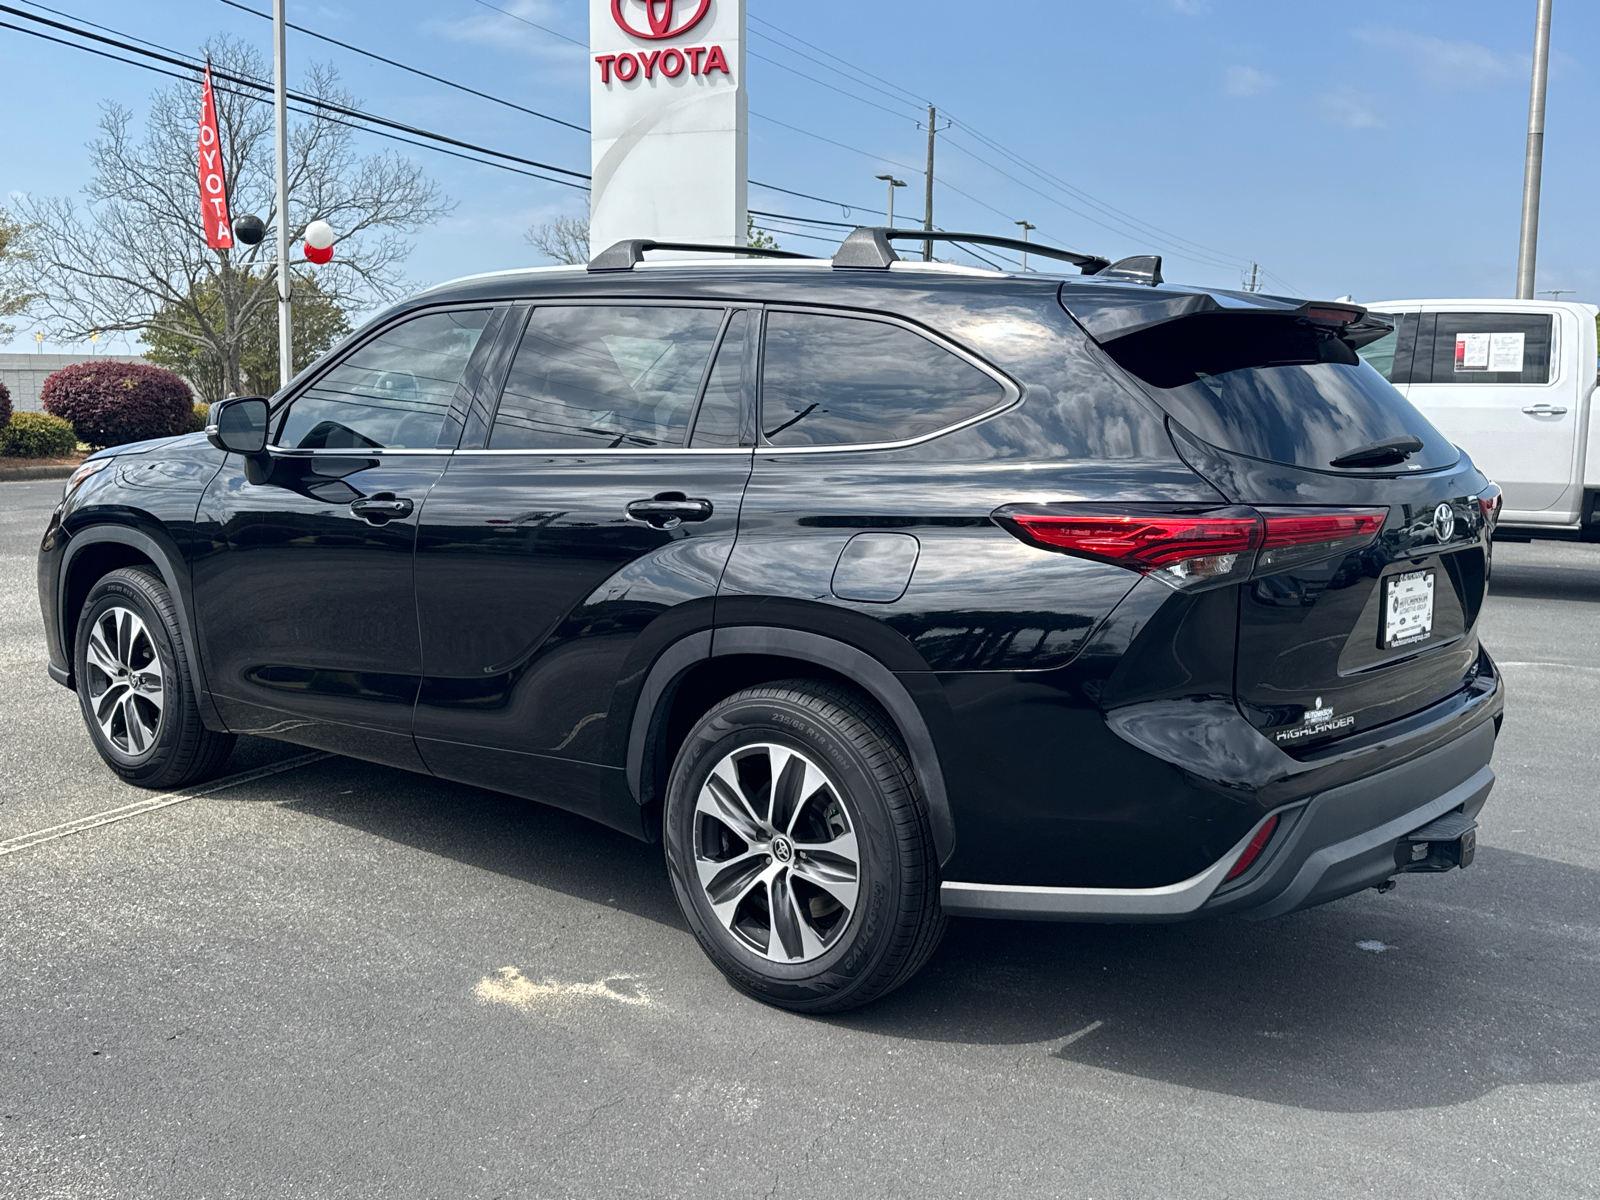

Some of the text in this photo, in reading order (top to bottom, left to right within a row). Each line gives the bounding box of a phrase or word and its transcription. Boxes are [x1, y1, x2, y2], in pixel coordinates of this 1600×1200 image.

[595, 45, 729, 83] TOYOTA
[201, 102, 231, 240] TOYOTA
[771, 712, 851, 771] 235/65 R18 106H
[1276, 716, 1354, 741] HIGHLANDER
